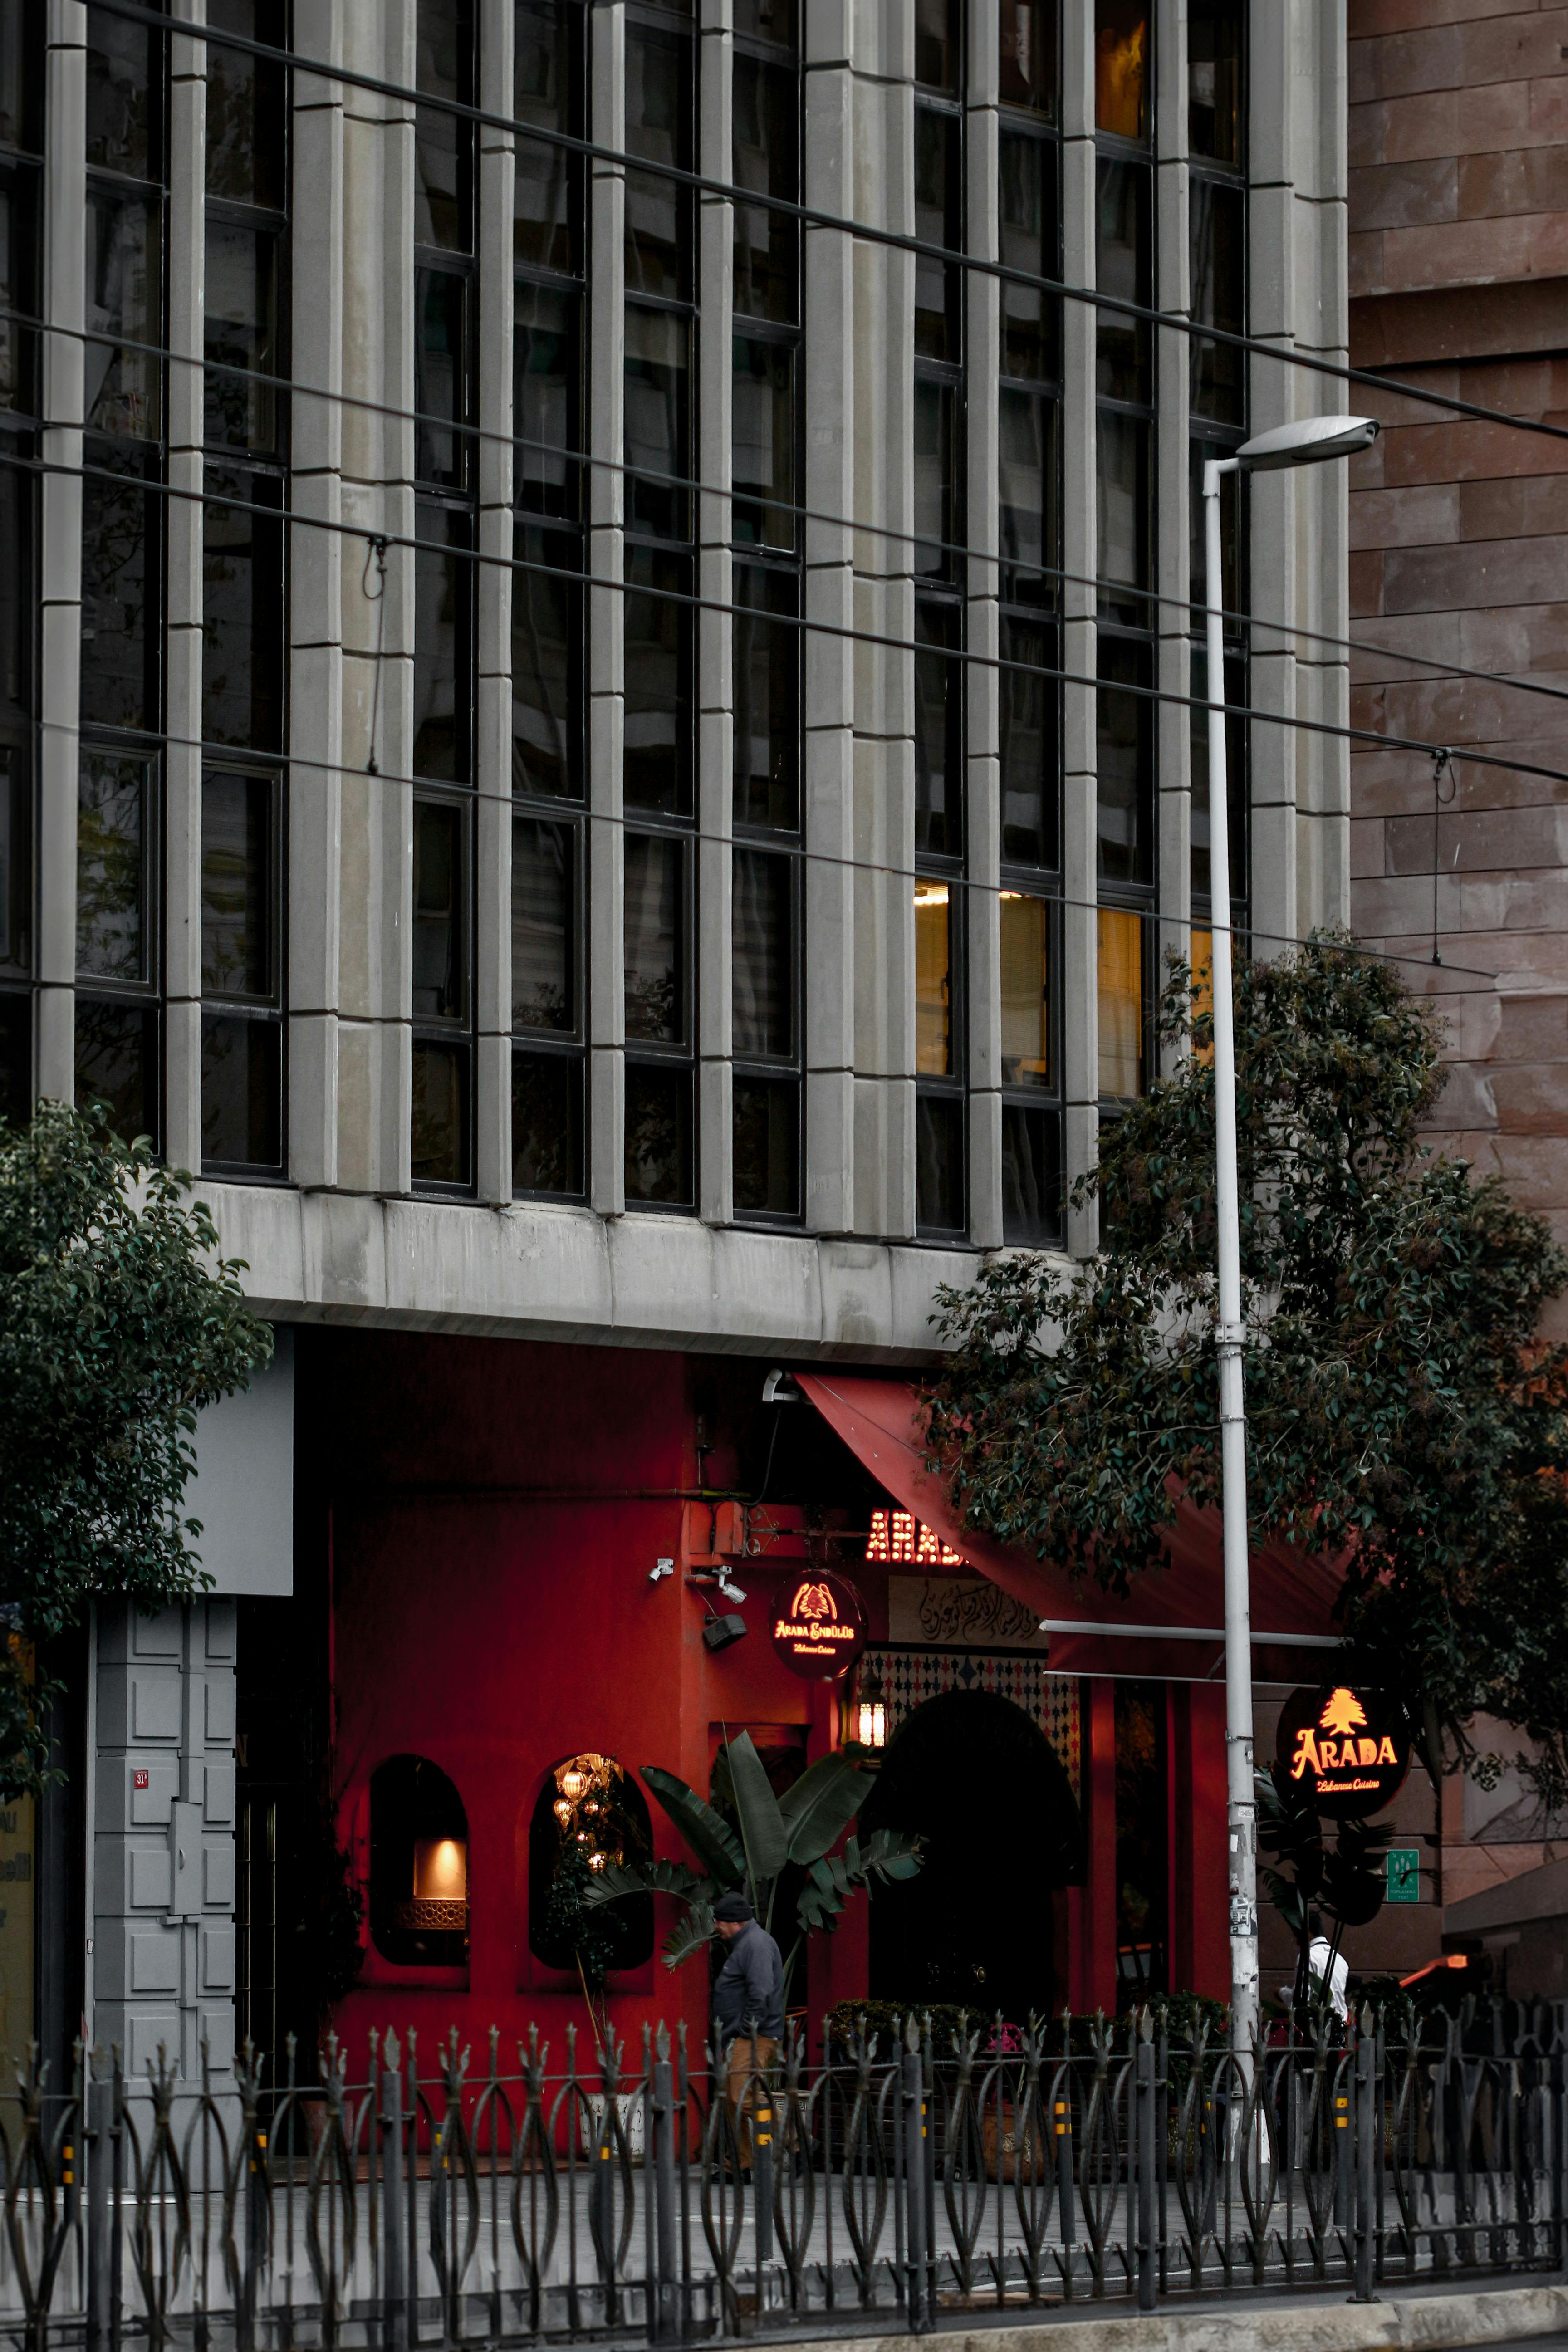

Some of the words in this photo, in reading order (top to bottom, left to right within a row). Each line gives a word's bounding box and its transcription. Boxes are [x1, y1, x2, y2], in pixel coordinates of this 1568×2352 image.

[774, 1620, 808, 1638] ARADA
[809, 1622, 854, 1640] ENDÜLÜS
[1290, 1729, 1398, 1779] ARADA
[1317, 1780, 1352, 1792] Lebanese
[1353, 1778, 1380, 1790] Cuisine
